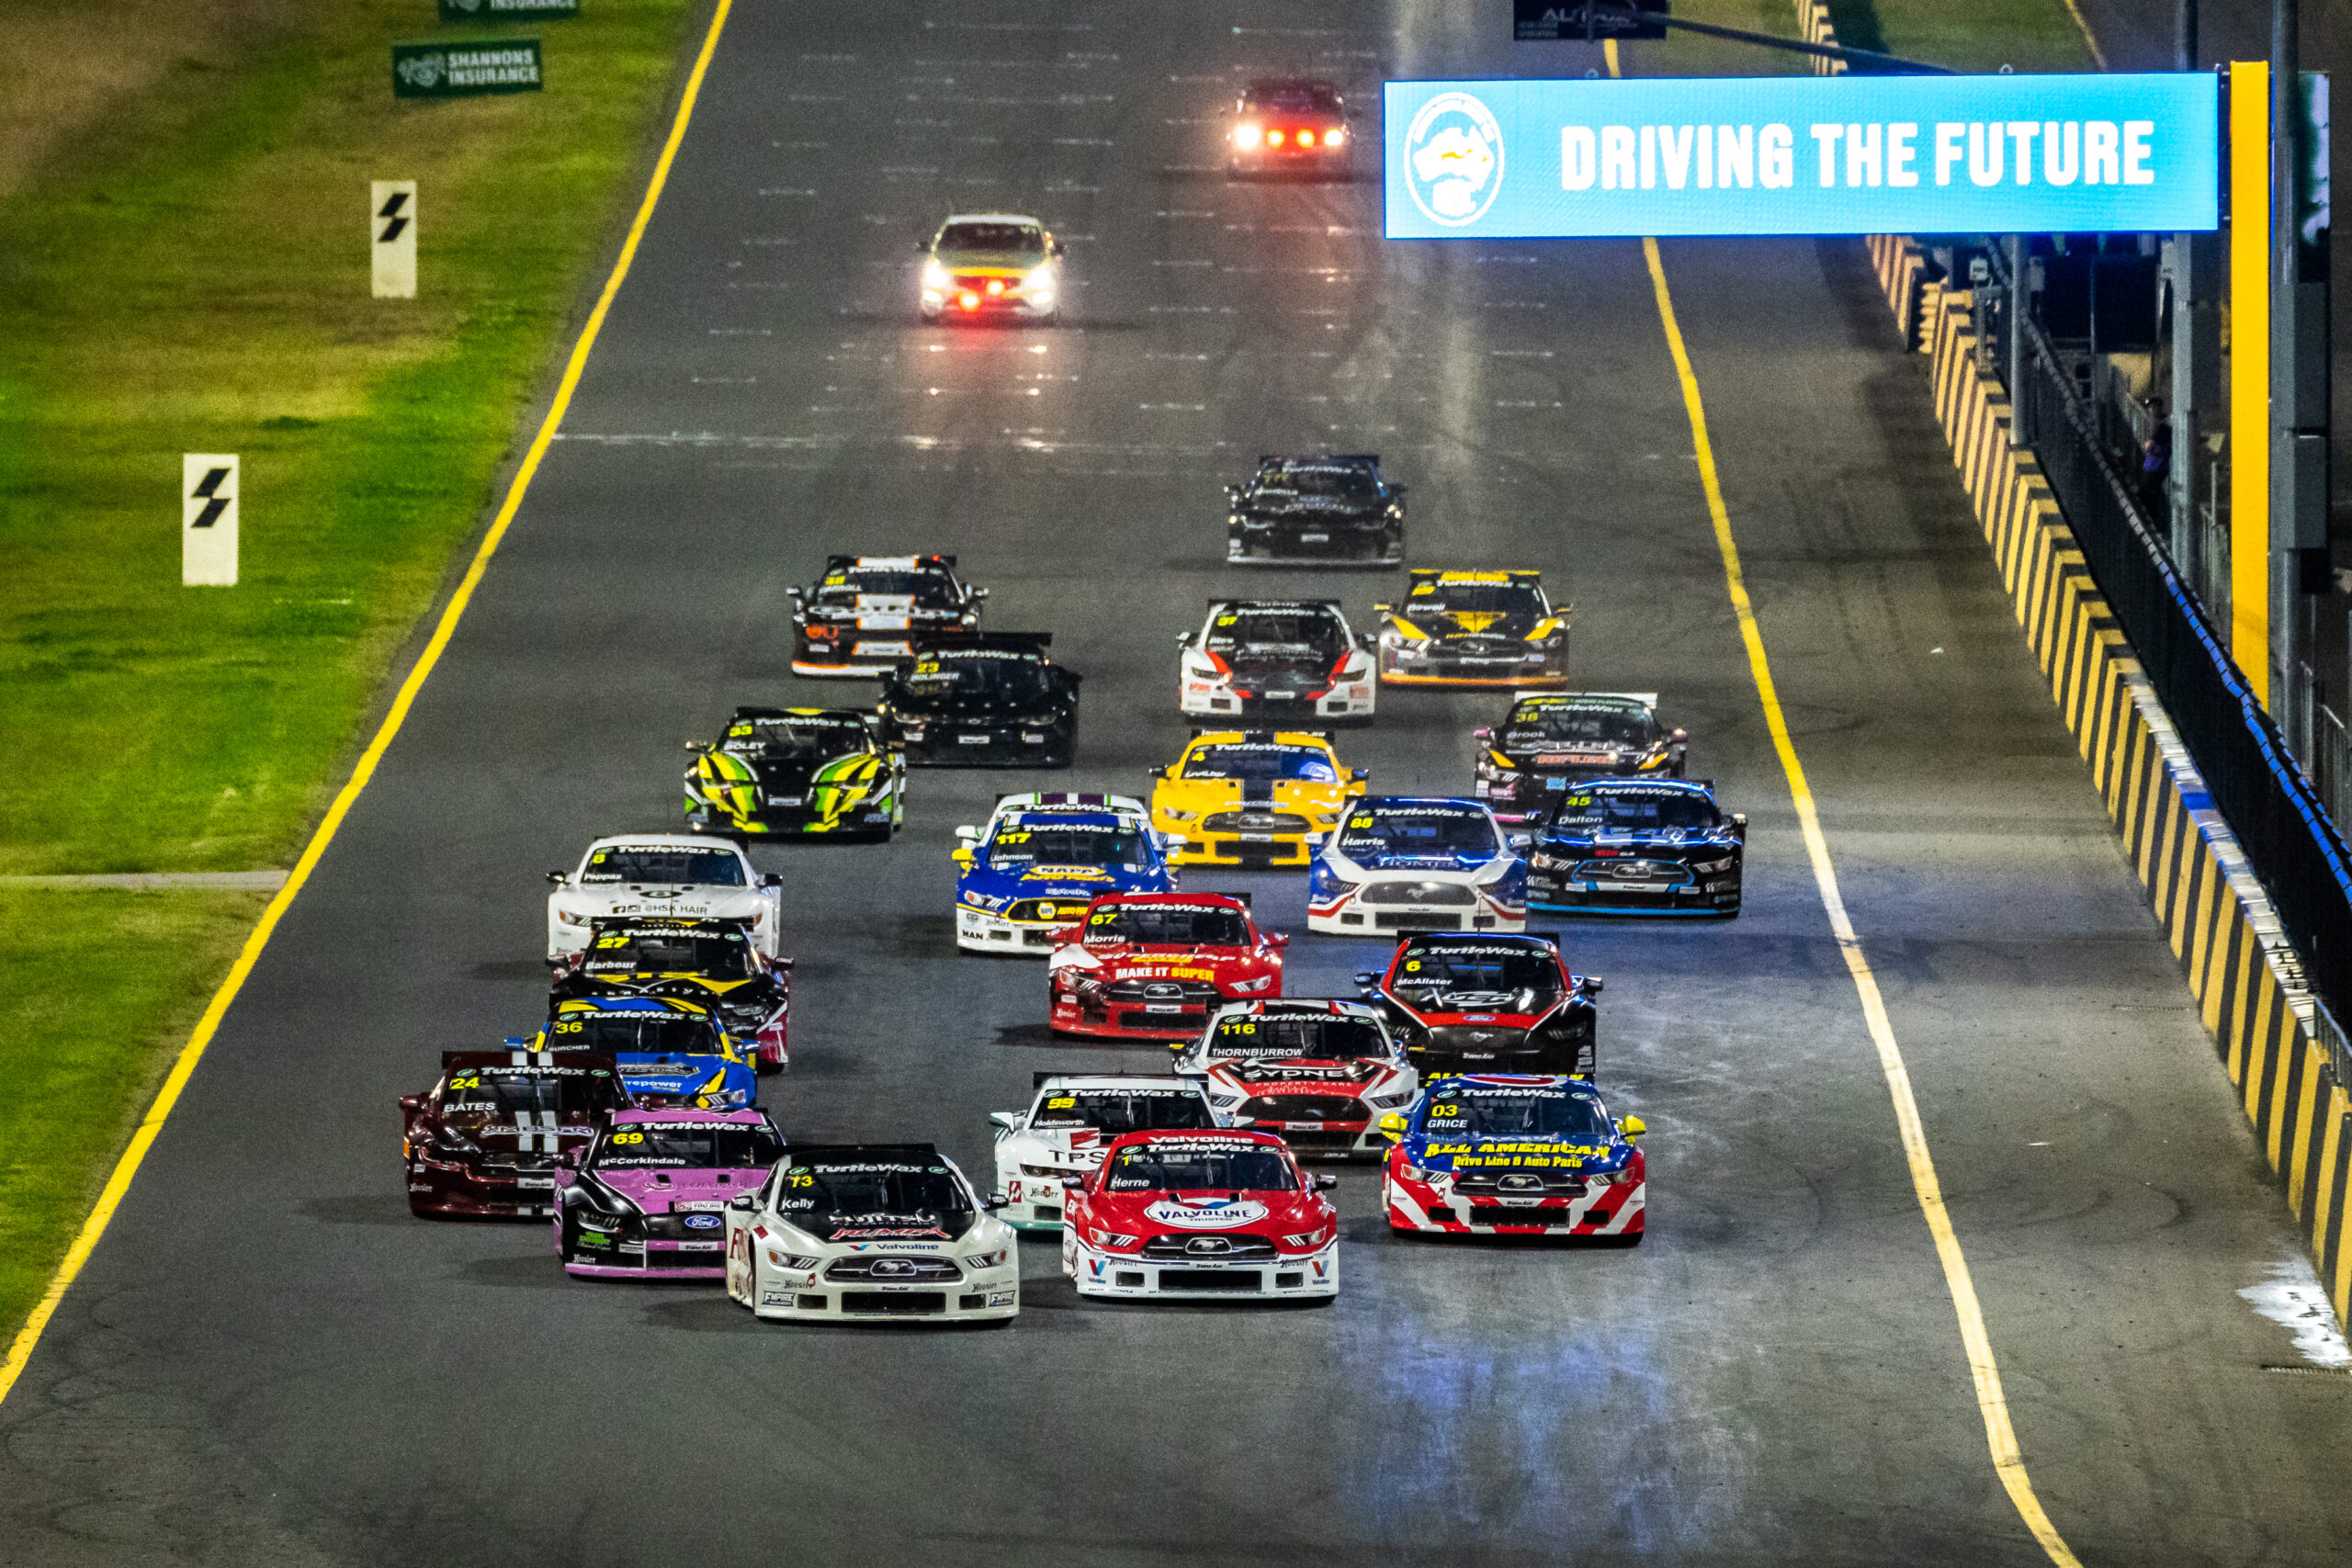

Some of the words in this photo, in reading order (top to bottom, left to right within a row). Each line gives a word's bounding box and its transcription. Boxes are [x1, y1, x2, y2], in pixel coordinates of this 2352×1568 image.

[448, 50, 534, 66] SHANNONS
[448, 66, 538, 85] INSURANCE
[1562, 123, 1792, 190] DRIVING
[1810, 122, 1918, 187] THE
[1936, 120, 2154, 186] FUTURE
[1540, 705, 1623, 713] TurtleWax
[1215, 744, 1301, 752] TurtleWax
[1192, 752, 1205, 761] 4
[1595, 788, 1683, 796] TurtleWax
[1566, 796, 1591, 807] 45
[1374, 808, 1465, 818] TurtleWax
[1558, 816, 1602, 825] Dalton
[1023, 824, 1114, 833] TurtleWax
[997, 833, 1031, 844] 117
[1341, 837, 1385, 846] Harris
[617, 845, 710, 855] TurtleWax
[593, 854, 605, 863] 8
[991, 853, 1033, 862] Johnson
[681, 905, 707, 915] HAIR
[1120, 904, 1215, 913] TurtleWax
[1091, 914, 1118, 925] 67
[622, 930, 720, 939] TurtleWax
[962, 930, 983, 940] MAN
[1084, 934, 1125, 943] Morris
[596, 938, 630, 949] 27
[1430, 947, 1527, 956] TurtleWax
[586, 961, 637, 970] Barbour
[1406, 961, 1421, 972] 6
[1115, 967, 1152, 979] MAKE
[1155, 967, 1170, 976] IT
[1170, 968, 1215, 982] SUPER
[1397, 977, 1453, 986] McAlister
[583, 1010, 685, 1020] TurtleWax
[1249, 1013, 1350, 1023] TurtleWax
[555, 1021, 583, 1034] 36
[1220, 1024, 1256, 1035] 116
[1212, 1048, 1304, 1056] THORNBURROW
[481, 1066, 585, 1077] TurtleWax
[1244, 1068, 1360, 1078] SYDNEY
[450, 1077, 480, 1089] 24
[624, 1080, 683, 1089] repower
[1069, 1089, 1175, 1098] TurtleWax
[1462, 1089, 1566, 1099] TurtleWax
[444, 1102, 496, 1112] BATES
[1046, 1098, 1076, 1109] 99
[1431, 1105, 1458, 1117] 03
[641, 1122, 749, 1132] TurtleWax
[1035, 1118, 1085, 1127] Holdsworth
[1427, 1120, 1468, 1129] GRICE
[613, 1133, 643, 1145] 69
[1147, 1144, 1254, 1153] TurtleWax
[1424, 1144, 1472, 1158] ALL
[1478, 1144, 1611, 1158] AMERICAN
[598, 1156, 685, 1167] McCorkindale
[1048, 1149, 1106, 1165] TPS
[1121, 1156, 1130, 1167] 1
[1453, 1156, 1482, 1167] Drive
[1485, 1156, 1510, 1167] Line
[1523, 1156, 1550, 1167] Auto
[1552, 1156, 1582, 1168] Parts
[813, 1164, 922, 1174] TurtleWax
[790, 1176, 813, 1188] 73
[1112, 1178, 1149, 1188] Herne
[781, 1198, 814, 1211] Kelly
[1159, 1209, 1251, 1220] VALVOLINE
[573, 1254, 596, 1264] Hoosier
[972, 1282, 997, 1292] Hoosier
[764, 1292, 795, 1302] EMPIRE
[991, 1292, 1014, 1303] EMPIRE
